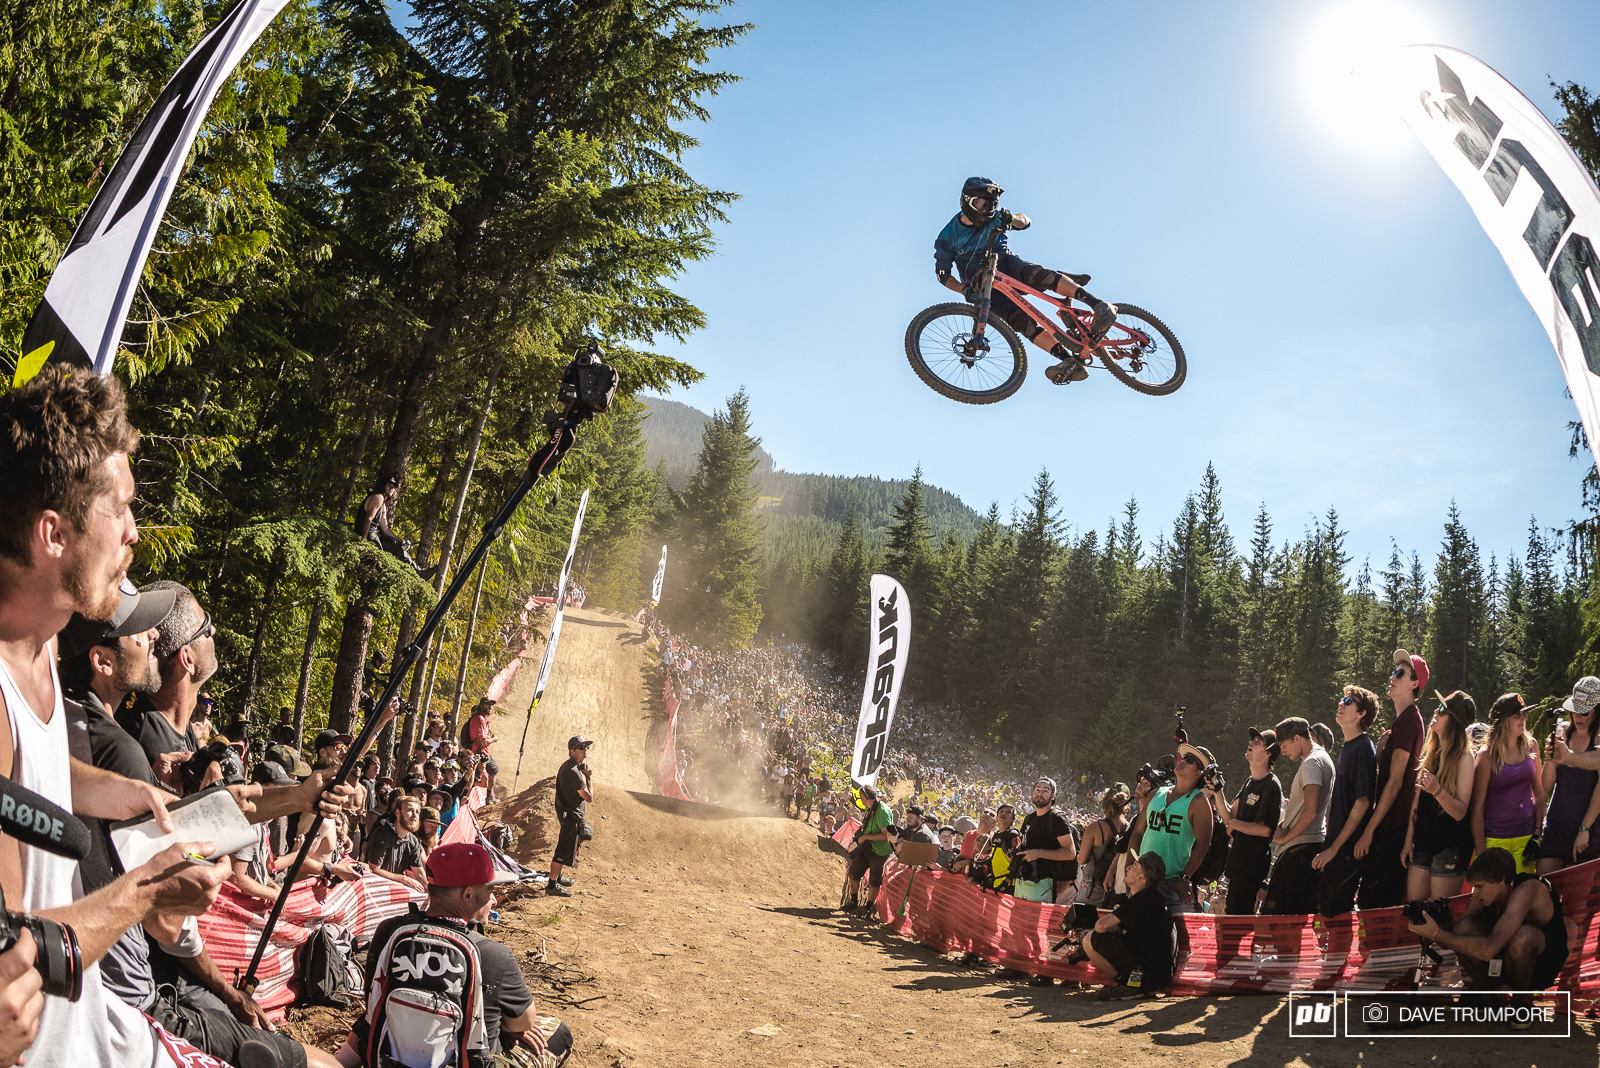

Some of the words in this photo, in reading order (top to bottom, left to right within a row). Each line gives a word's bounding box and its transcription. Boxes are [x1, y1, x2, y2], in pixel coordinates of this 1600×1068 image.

[1010, 290, 1028, 306] ROCKY
[1028, 305, 1058, 331] MOUNTAIN
[1, 793, 64, 842] RØDE
